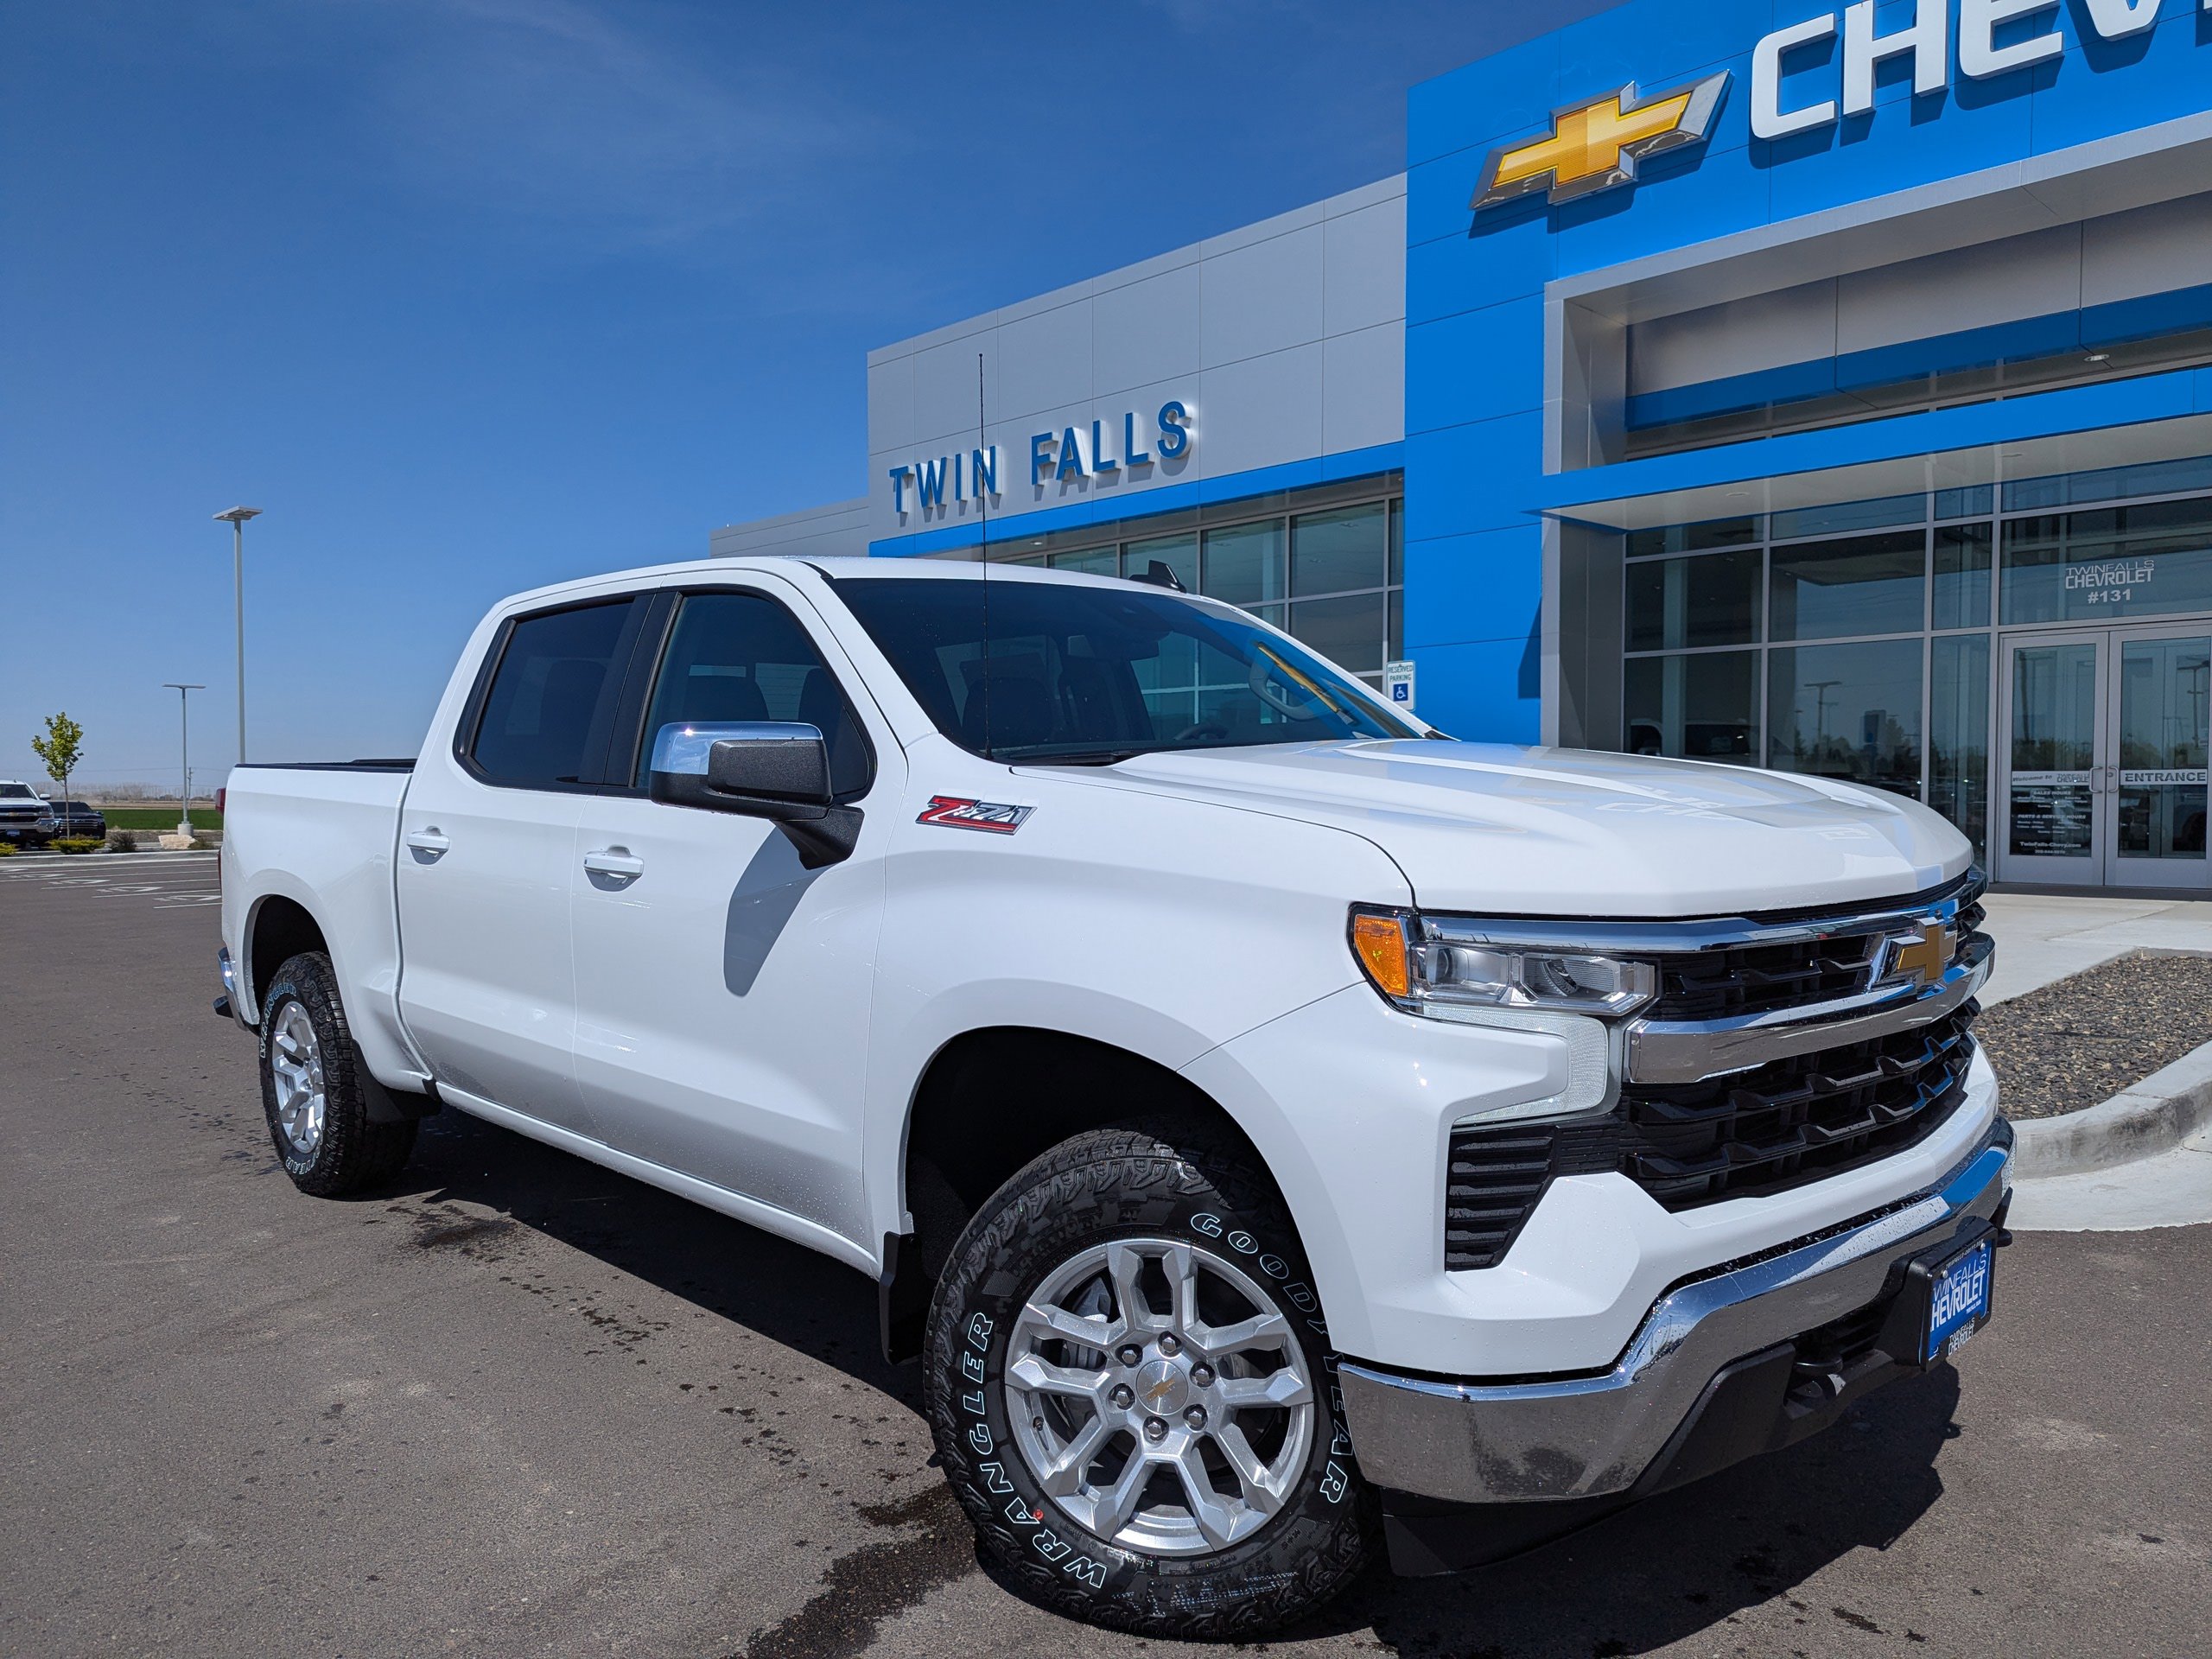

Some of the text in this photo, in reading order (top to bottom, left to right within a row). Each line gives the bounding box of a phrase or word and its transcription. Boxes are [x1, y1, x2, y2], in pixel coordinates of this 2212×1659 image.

[1751, 0, 2212, 139] CHE
[888, 400, 1192, 513] TWIN FALLS
[2065, 559, 2155, 576] TWINFALLS
[2065, 568, 2155, 589] CHEVROLET
[2087, 588, 2132, 604] #131
[1388, 664, 1414, 674] RESERVED
[1389, 674, 1412, 683] PARKING
[2124, 771, 2207, 783] ENTRANCE
[915, 795, 1038, 836] Z71
[1932, 1253, 1987, 1302] WINFALLS
[1929, 1268, 1986, 1333] HEVROLET
[962, 1312, 1108, 1589] WRANGLER
